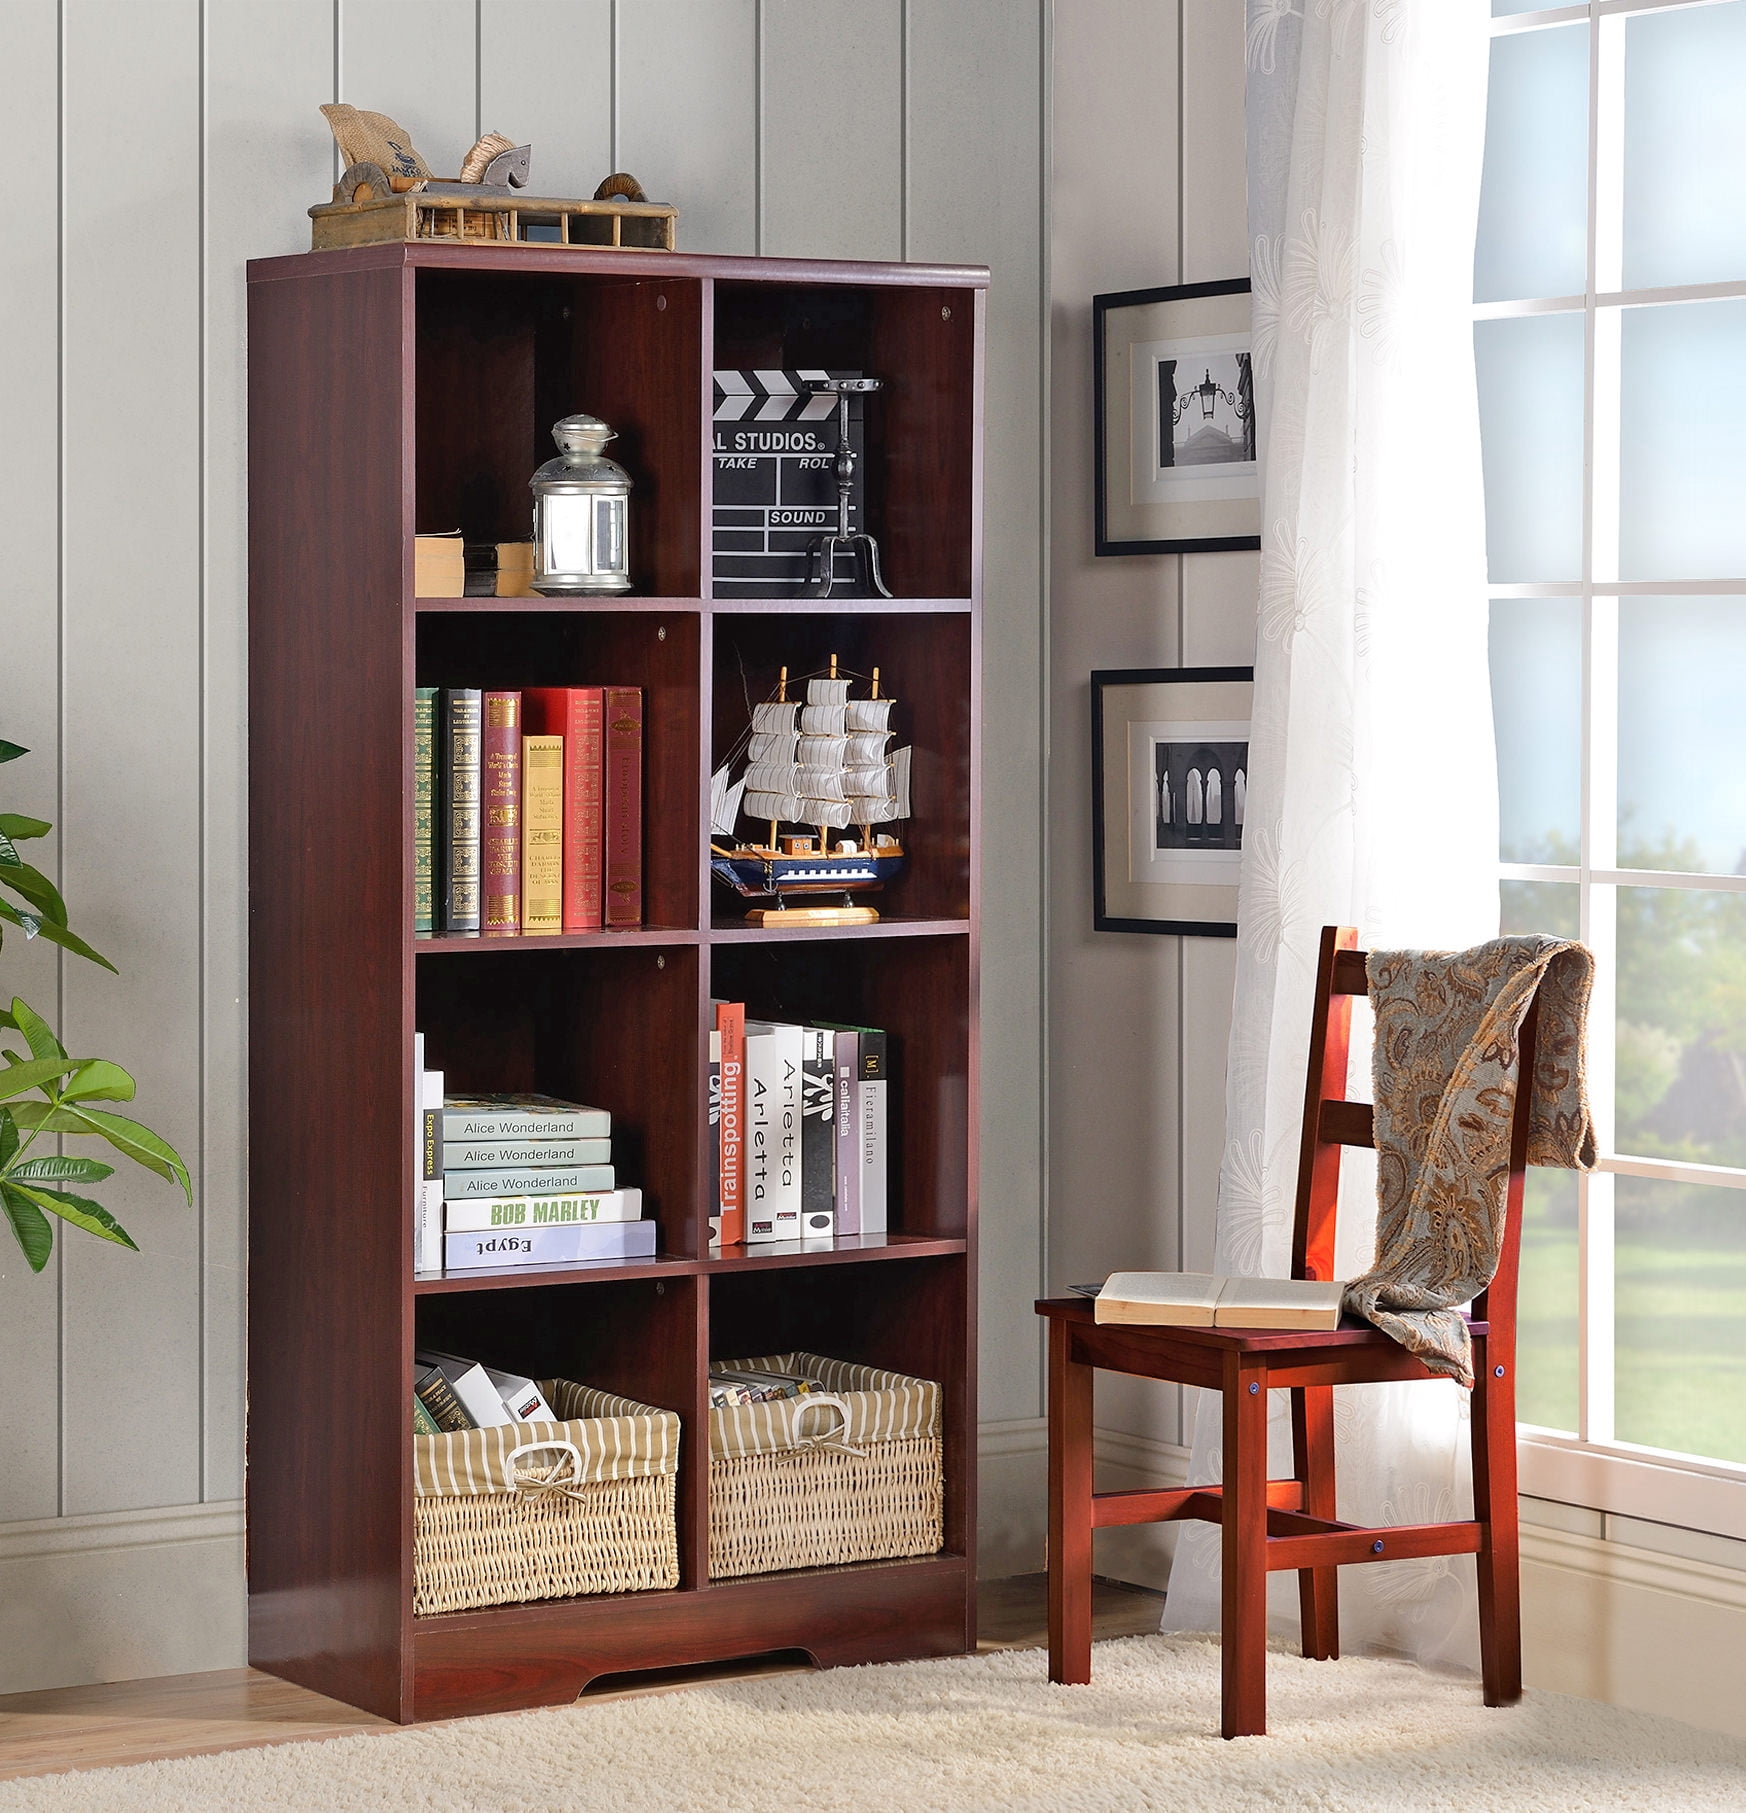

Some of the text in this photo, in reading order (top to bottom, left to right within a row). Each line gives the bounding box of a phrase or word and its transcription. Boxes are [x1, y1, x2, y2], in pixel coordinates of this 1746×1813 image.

[713, 432, 727, 450] L
[718, 457, 757, 469] TAKE
[770, 510, 826, 524] SOUND
[464, 1121, 574, 1134] Alice Wonderland
[782, 1059, 796, 1187] Arletta
[865, 1086, 877, 1165] Fieramilano
[425, 1114, 435, 1176] Expo Express
[754, 1078, 769, 1200] Arletta
[464, 1148, 575, 1162] Alice Wonderland
[466, 1176, 578, 1192] Alice Wonderland
[490, 1199, 600, 1226] BOB MARLEY
[477, 1238, 532, 1255] Egypt
